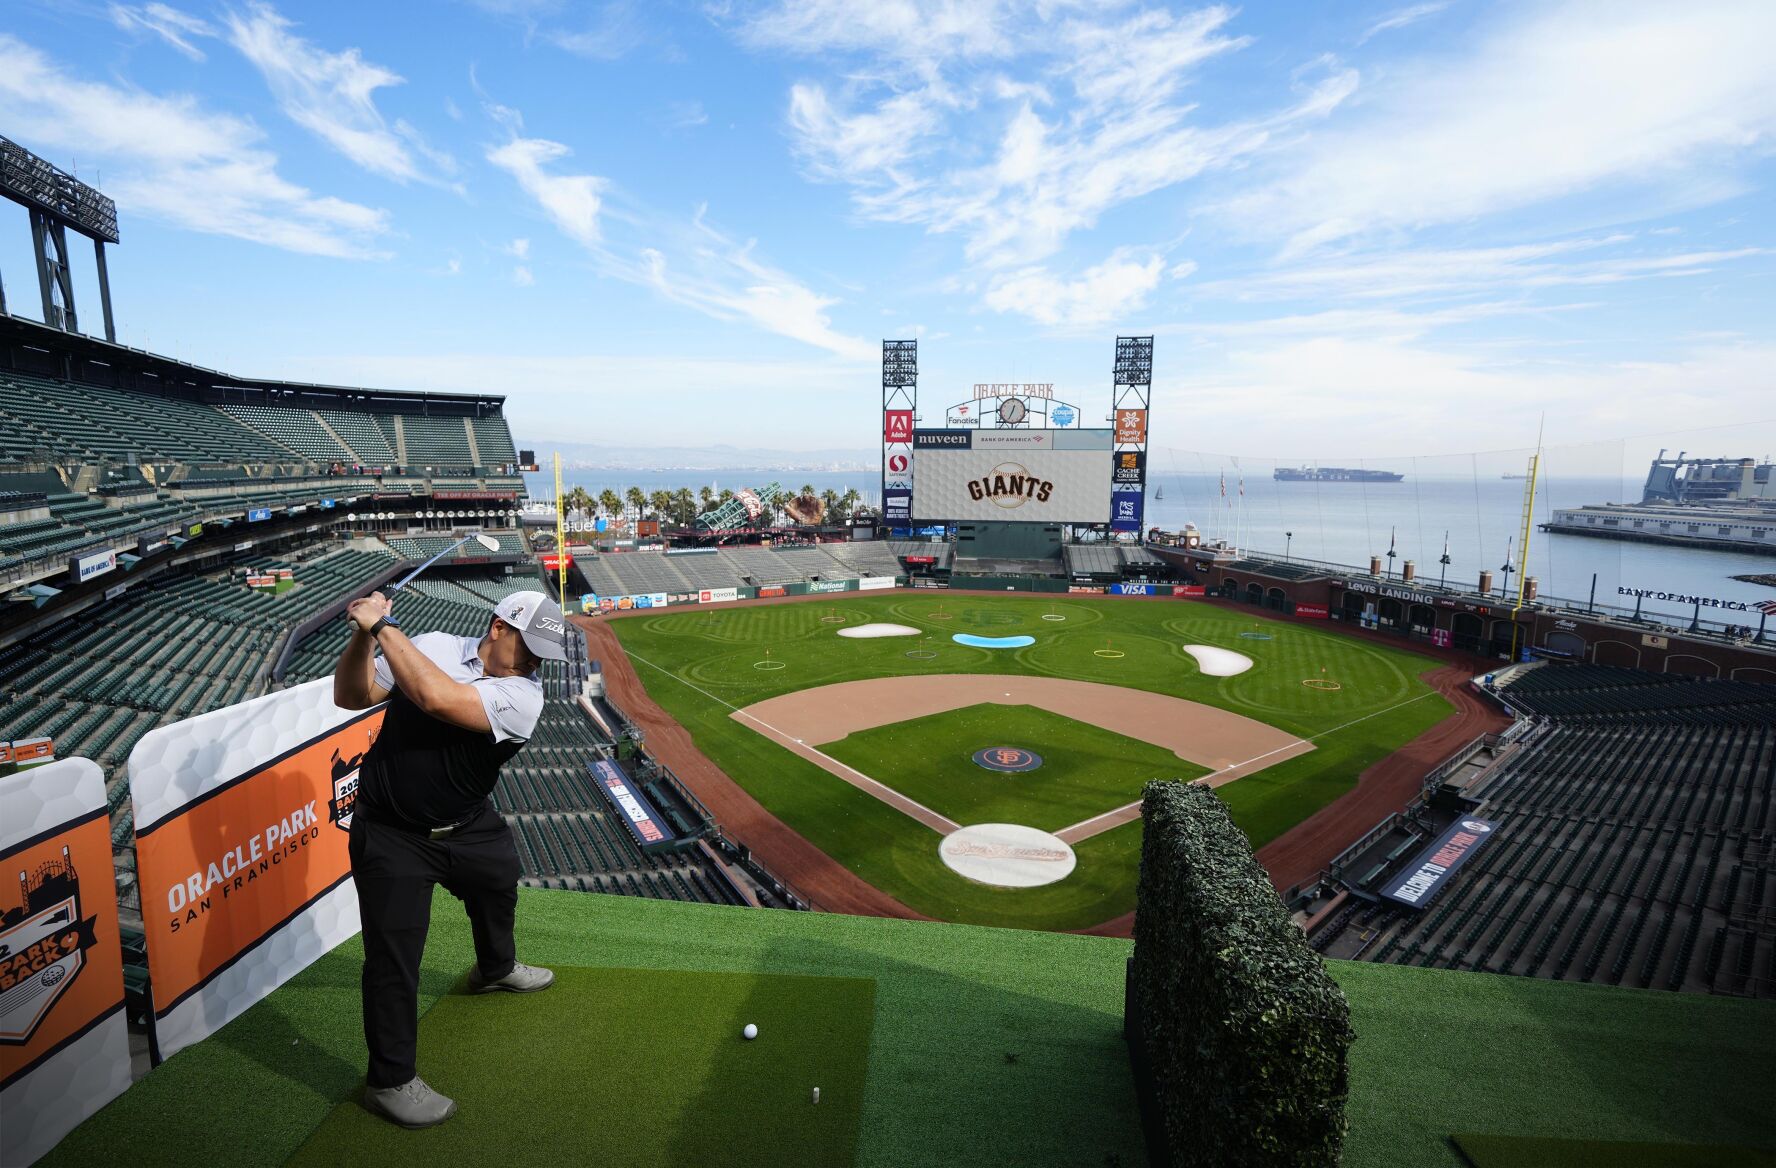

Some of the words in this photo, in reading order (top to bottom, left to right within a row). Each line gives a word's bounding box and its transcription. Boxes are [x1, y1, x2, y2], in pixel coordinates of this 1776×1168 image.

[974, 384, 1019, 400] ORACLE
[1023, 384, 1053, 400] PARK
[948, 416, 979, 425] Fanatics
[919, 433, 967, 444] nuveen
[1119, 429, 1141, 437] Dignity
[967, 474, 1054, 503] GIANTS
[819, 581, 846, 590] National
[1120, 585, 1147, 595] VISA
[1379, 587, 1434, 605] LANDING
[1618, 586, 1654, 599] BANK
[1657, 592, 1675, 601] OF
[1677, 595, 1748, 612] AMERICA
[340, 778, 359, 796] 202
[168, 834, 263, 913] ORACLE
[266, 800, 318, 851] PARK
[170, 897, 211, 933] SAN
[223, 826, 319, 899] FRANCISCO
[1393, 869, 1441, 903] WELCOME
[1421, 862, 1447, 875] TO
[1, 948, 63, 990] BACK
